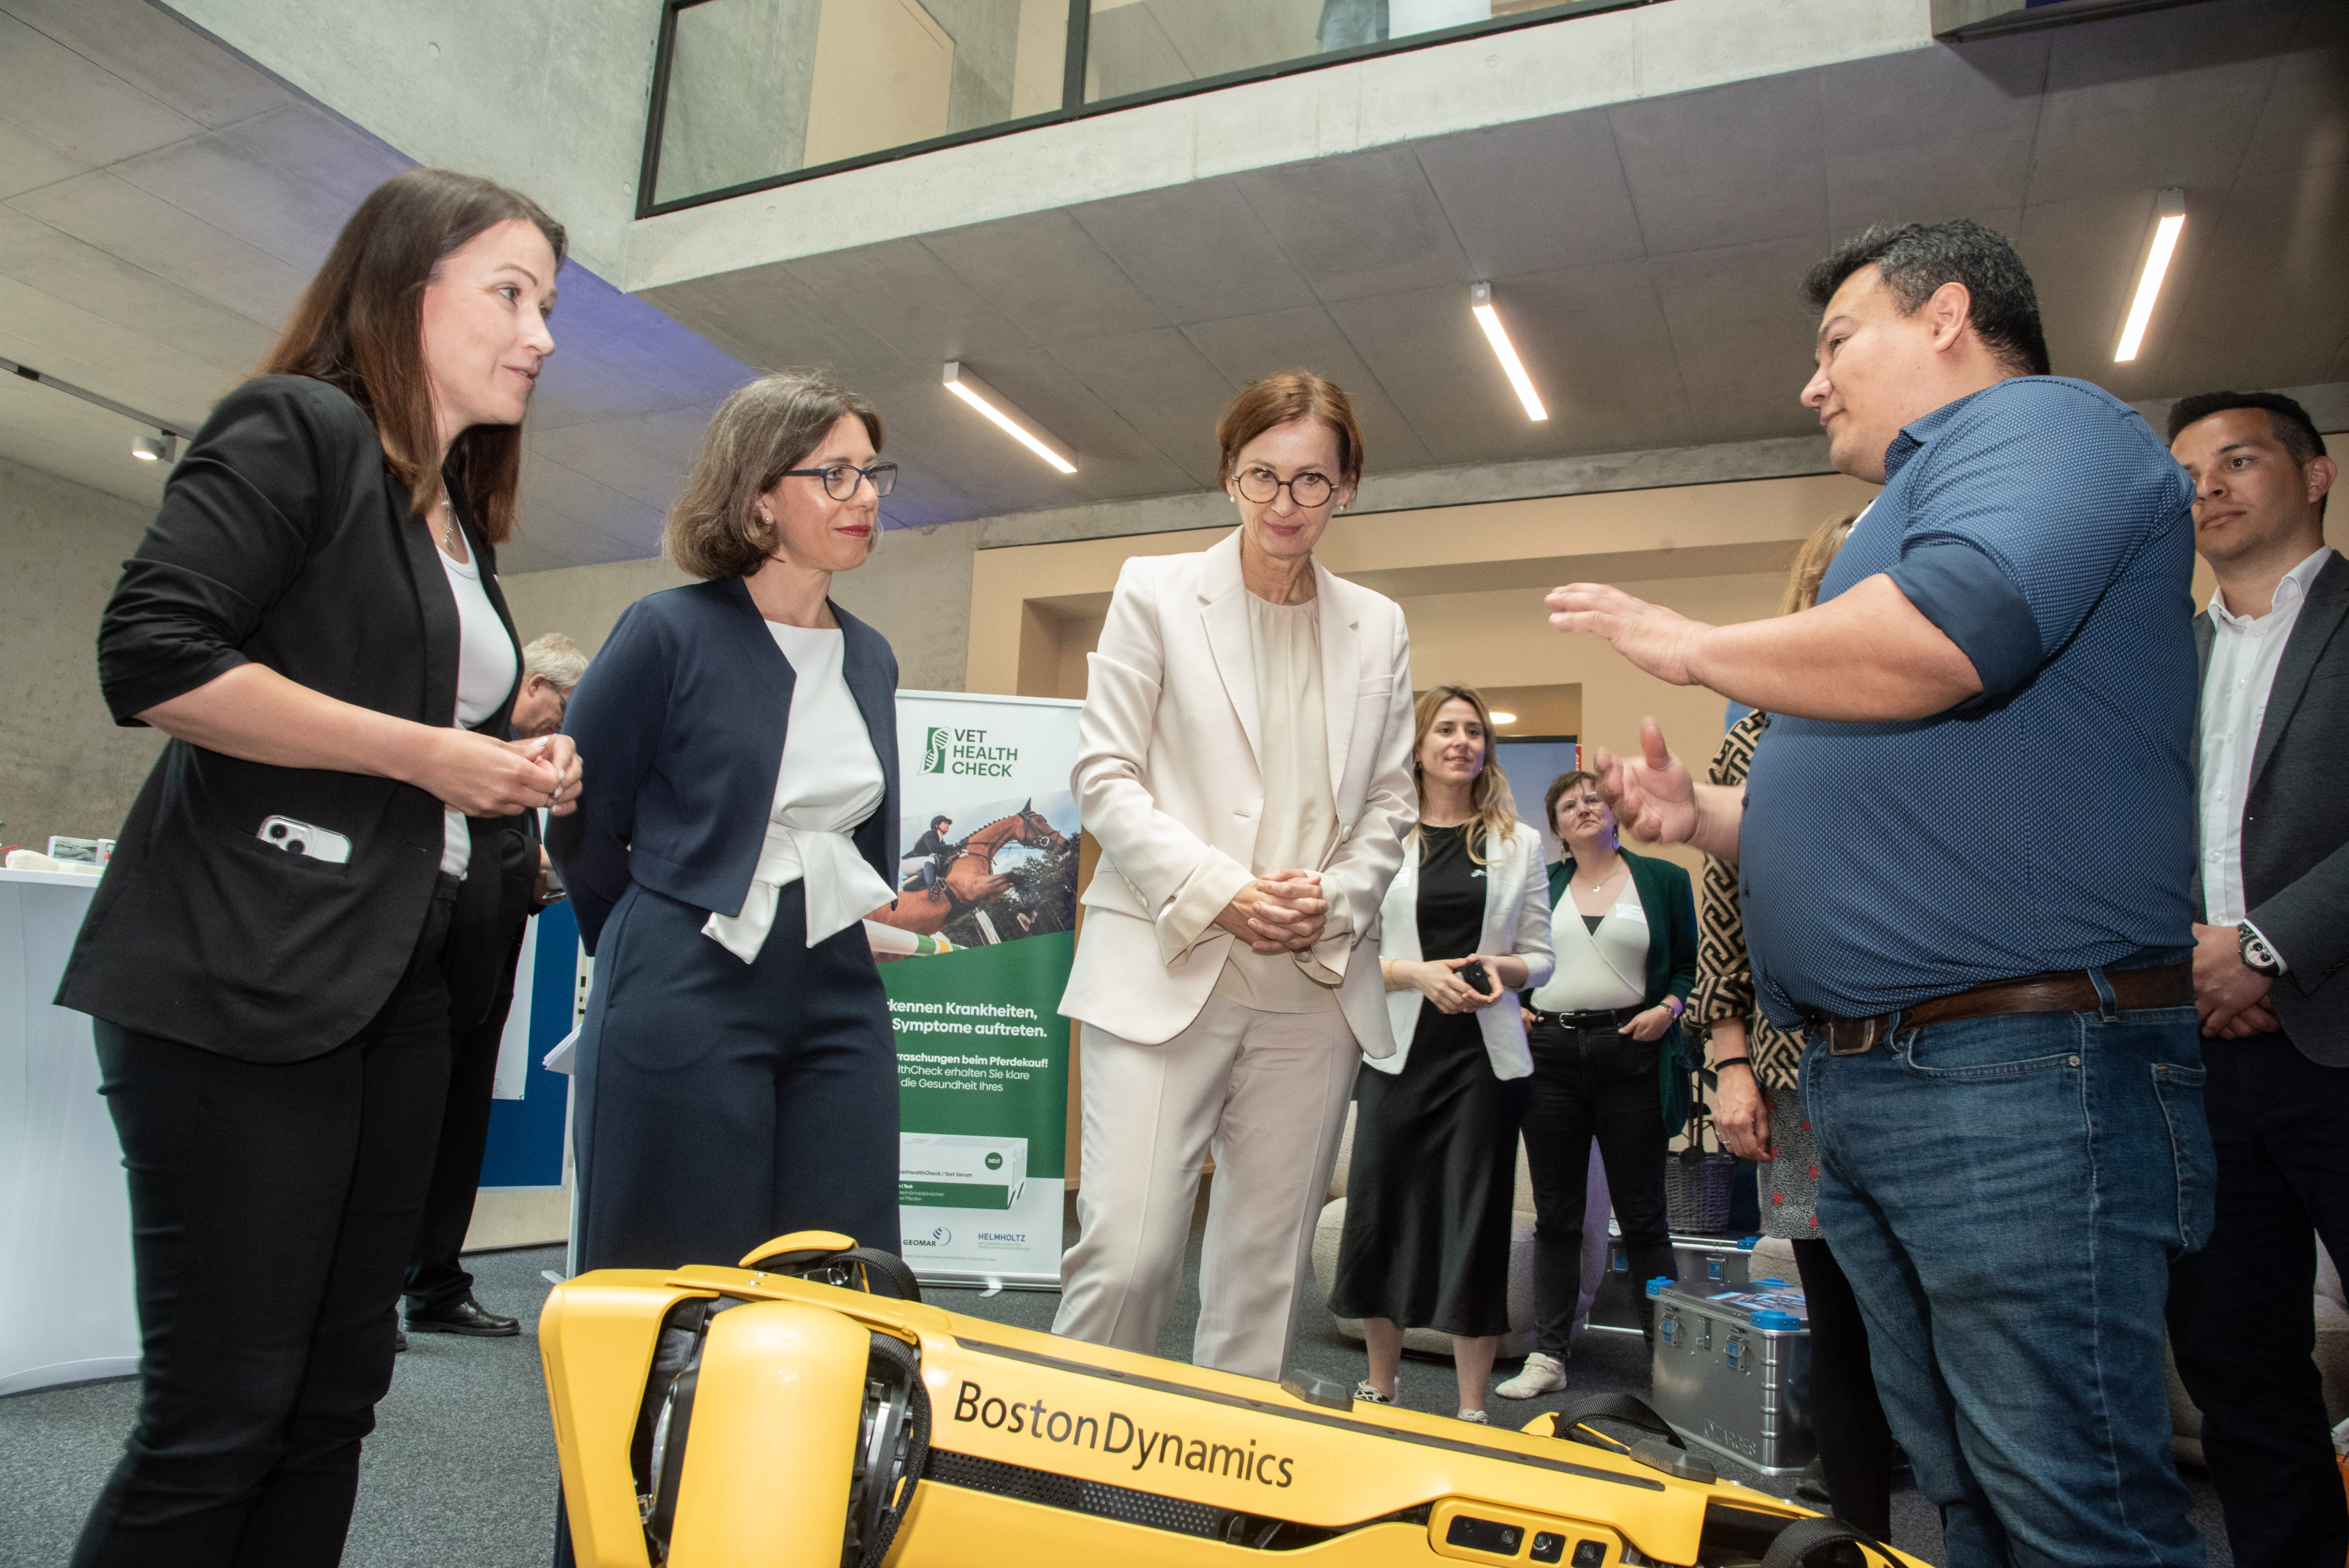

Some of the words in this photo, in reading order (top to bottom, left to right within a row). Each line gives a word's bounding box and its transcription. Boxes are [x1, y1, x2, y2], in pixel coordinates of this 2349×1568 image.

[954, 729, 987, 743] VET
[953, 745, 1018, 761] HEALTH
[952, 761, 1012, 777] CHECK
[946, 1002, 1037, 1020] Krankheiten,
[892, 1018, 972, 1034] Symptome
[975, 1022, 1048, 1037] auftreten.
[962, 1055, 987, 1065] beim
[989, 1057, 1048, 1068] Pferdekauf!
[945, 1067, 987, 1078] erhalten
[989, 1069, 1003, 1078] Sie
[1006, 1070, 1030, 1080] klare
[901, 1078, 916, 1087] die
[919, 1078, 978, 1090] Gesundheit
[979, 1082, 1003, 1091] Ihres
[978, 1233, 1026, 1242] HELMHOLTZ
[954, 1380, 1294, 1488] BostonDynamics
